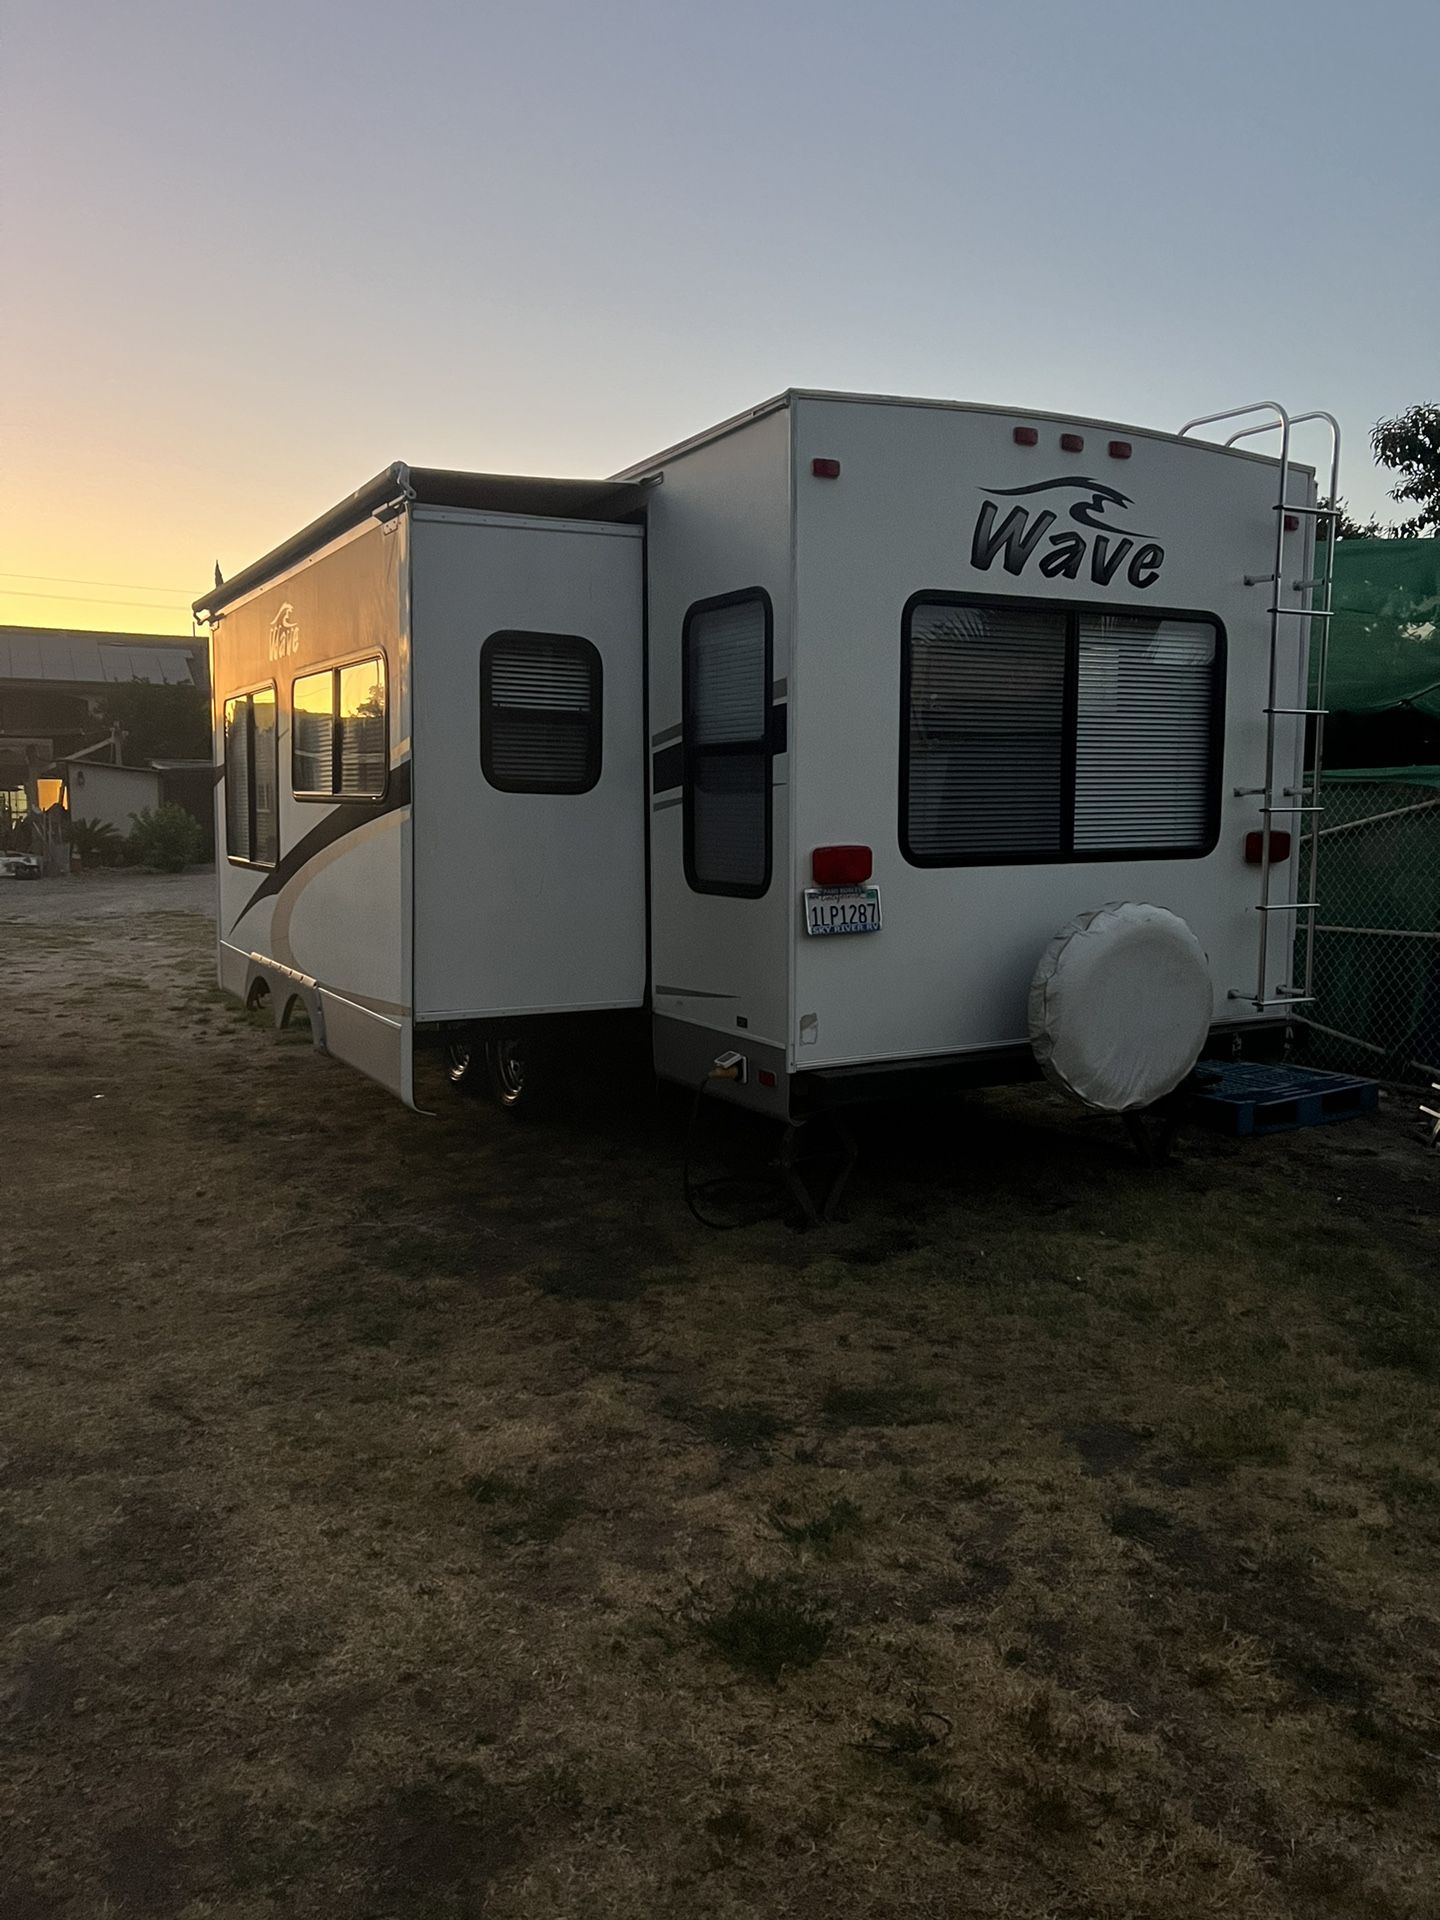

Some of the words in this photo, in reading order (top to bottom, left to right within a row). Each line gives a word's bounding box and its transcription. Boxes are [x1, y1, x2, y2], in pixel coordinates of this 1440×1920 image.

[970, 499, 1165, 589] Wave
[269, 624, 299, 661] Wave
[812, 903, 876, 927] 1LP1287
[812, 926, 833, 935] SKY
[834, 924, 864, 933] RIVER
[866, 923, 879, 931] RV
